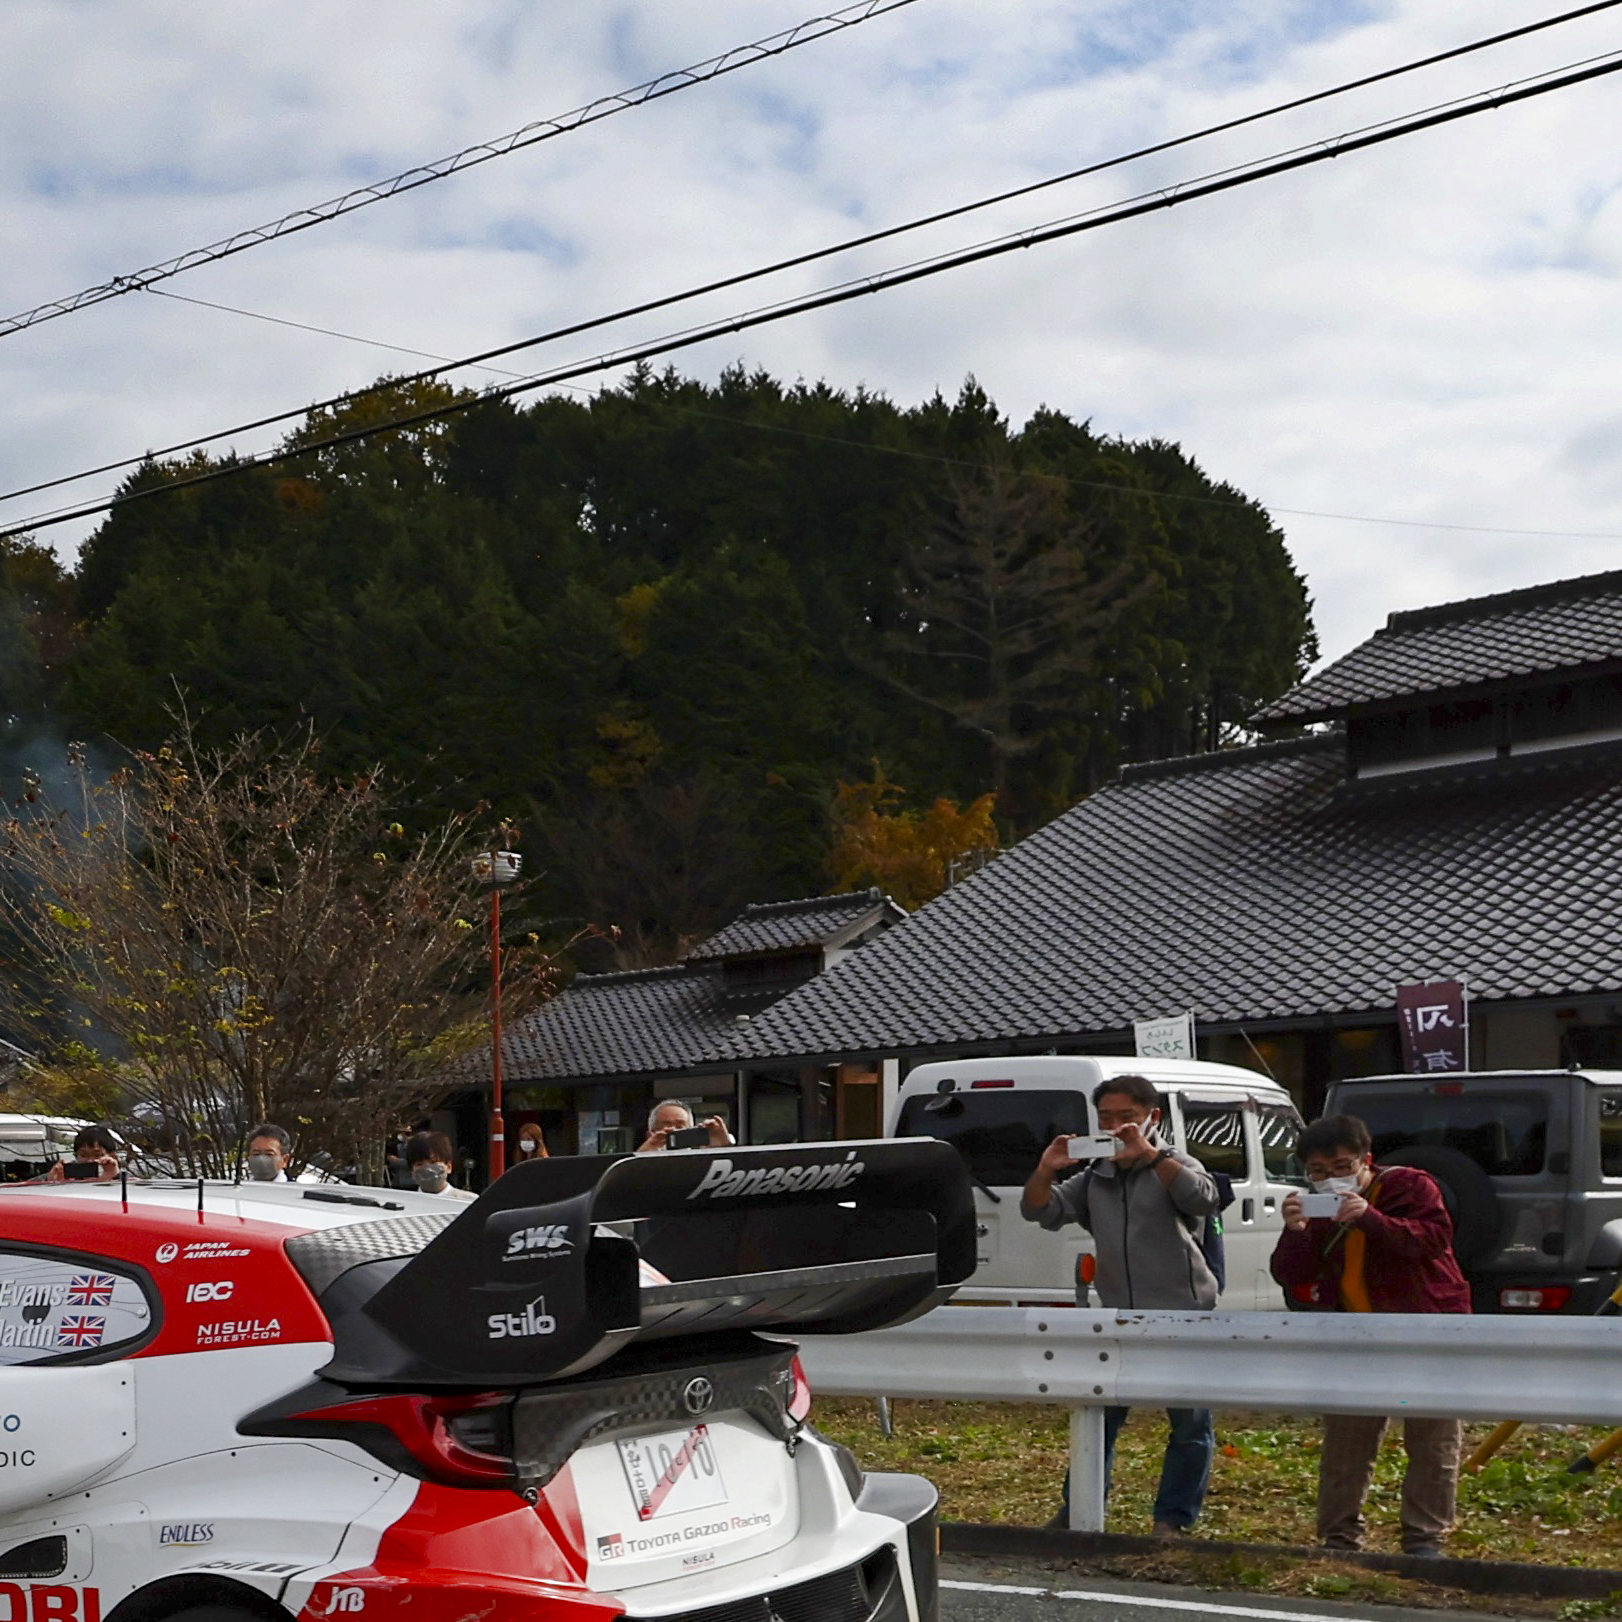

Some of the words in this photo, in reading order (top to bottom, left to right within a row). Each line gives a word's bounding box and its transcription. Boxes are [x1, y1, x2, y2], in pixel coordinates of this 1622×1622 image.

[686, 1151, 865, 1200] Panasonic
[183, 1242, 231, 1251] JAPAN
[507, 1225, 574, 1254] SWS
[183, 1249, 250, 1259] AIRLINES
[198, 1318, 281, 1336] NISULA
[488, 1295, 556, 1338] Stilo
[160, 1523, 215, 1544] ENDLESS
[599, 1544, 624, 1560] GR
[627, 1531, 681, 1553] TOYOTA
[684, 1522, 729, 1541] GAZOO
[730, 1513, 771, 1531] Racing
[682, 1553, 715, 1566] NISULA
[325, 1587, 365, 1615] JTB
